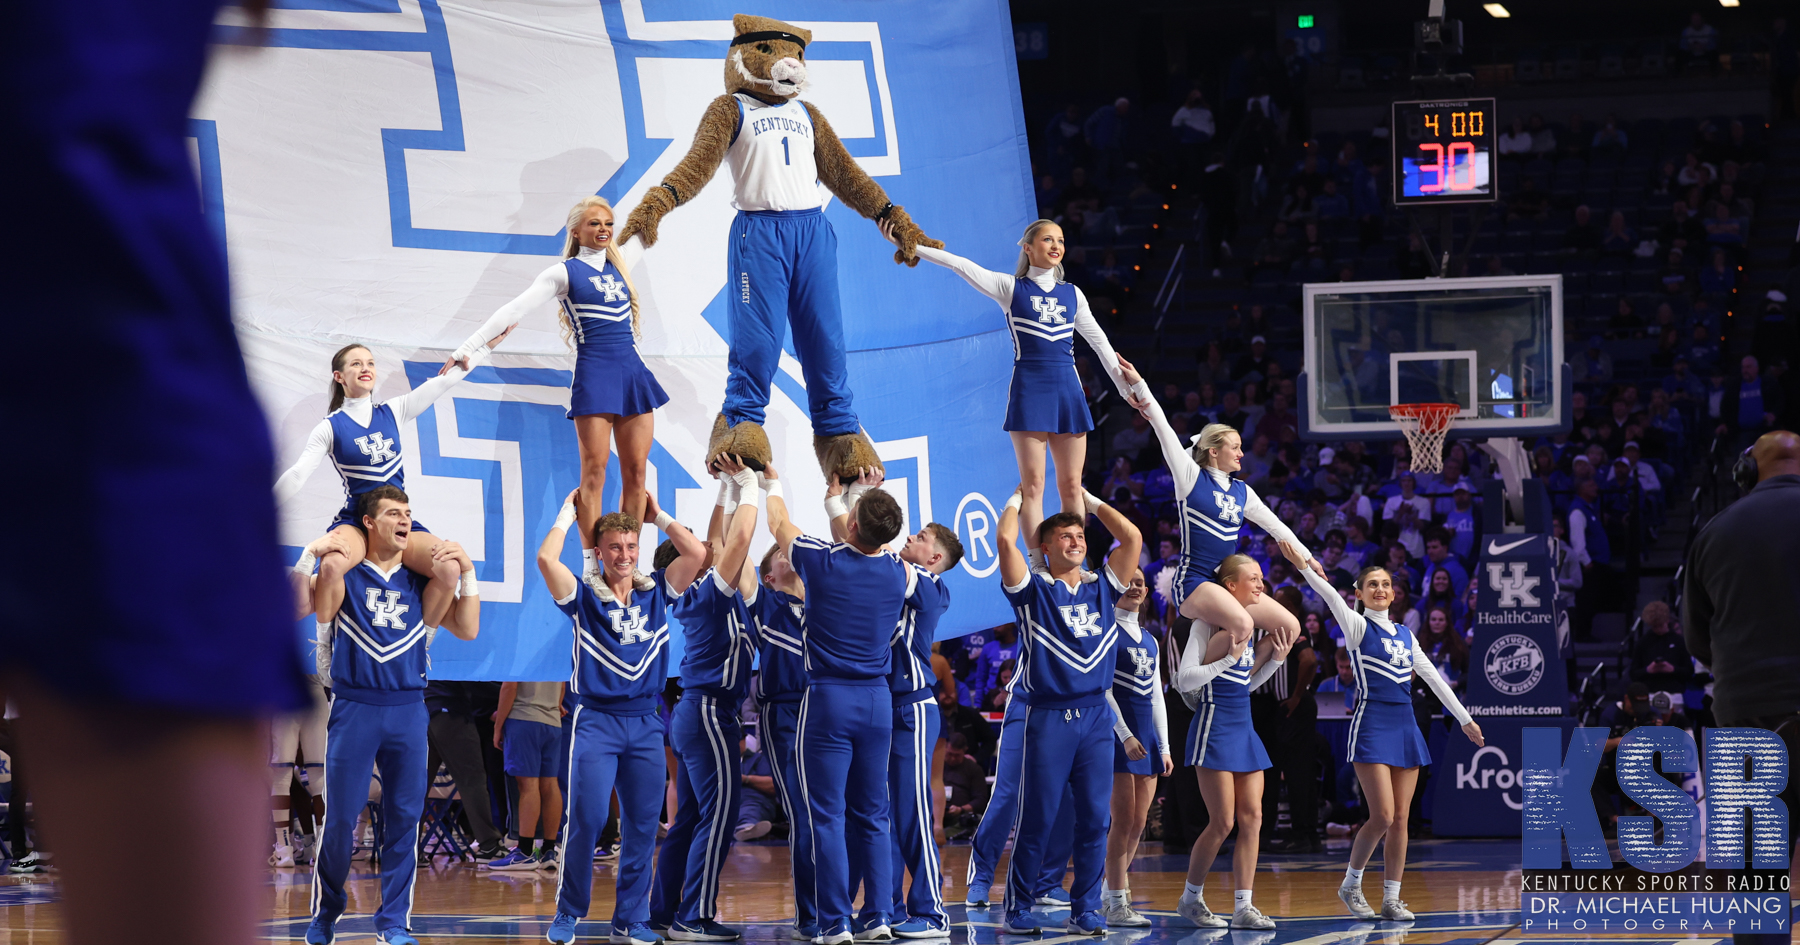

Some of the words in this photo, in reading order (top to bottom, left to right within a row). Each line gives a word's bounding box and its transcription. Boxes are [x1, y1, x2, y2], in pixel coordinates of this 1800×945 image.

[1419, 101, 1469, 109] DAKTRONICS
[752, 116, 809, 139] KENTUCKY
[781, 136, 791, 166] 1
[1418, 141, 1476, 192] 30
[587, 273, 629, 303] UK
[741, 271, 750, 304] KENTUCKY
[1029, 295, 1067, 325] UK
[353, 431, 398, 466] UK
[1212, 490, 1243, 525] UK
[1485, 562, 1541, 608] UK
[365, 587, 410, 631] UK
[1057, 602, 1103, 638] UK
[1477, 610, 1552, 625] HealthCare
[607, 604, 656, 646] UK
[1126, 646, 1155, 677] UK
[1380, 637, 1413, 668] UK
[1490, 637, 1534, 655] KENTUCKY
[1501, 655, 1530, 674] KFB
[1489, 673, 1510, 692] FARM
[1511, 669, 1541, 693] BUREAU
